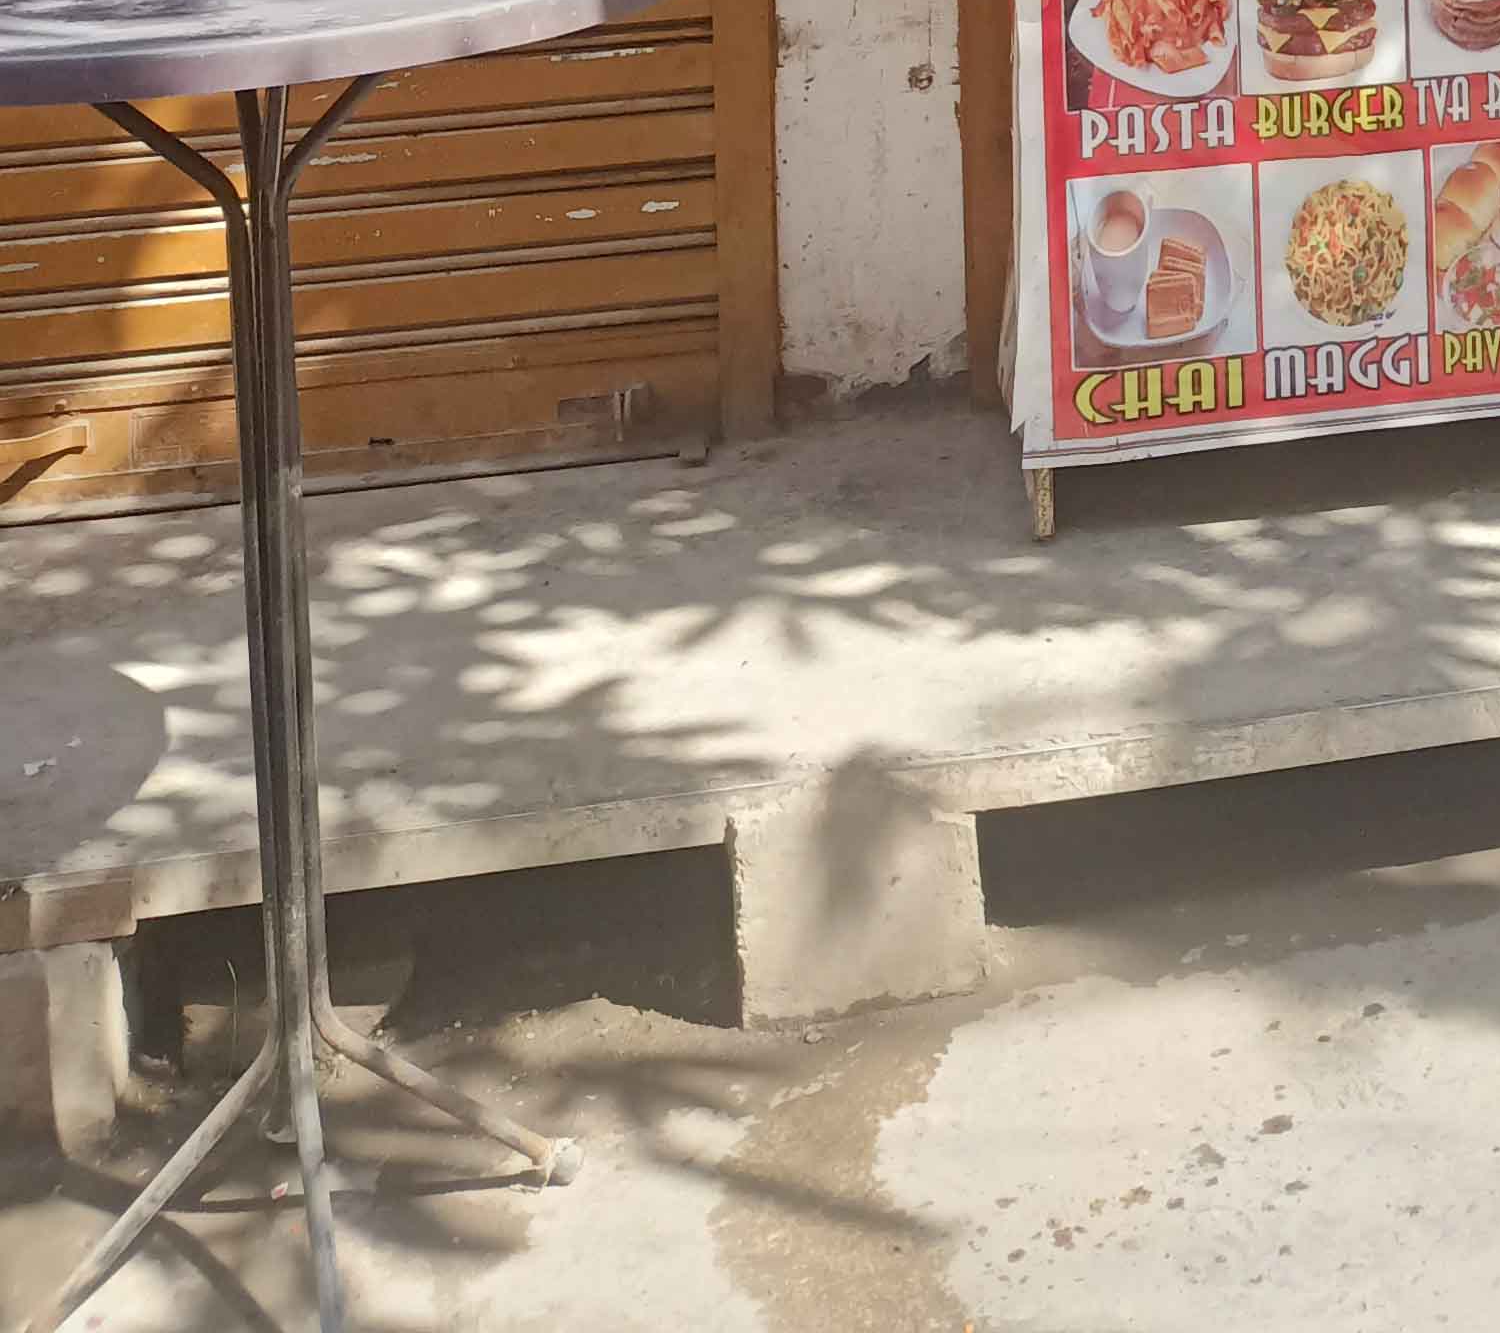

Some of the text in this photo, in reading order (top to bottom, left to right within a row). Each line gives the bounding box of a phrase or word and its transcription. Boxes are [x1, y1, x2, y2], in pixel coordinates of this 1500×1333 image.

[1079, 97, 1237, 159] PASTA
[1252, 85, 1404, 138] BURGER
[1413, 74, 1470, 127] TVA
[1073, 357, 1244, 424] CHAI
[1264, 334, 1431, 399] MAGGI
